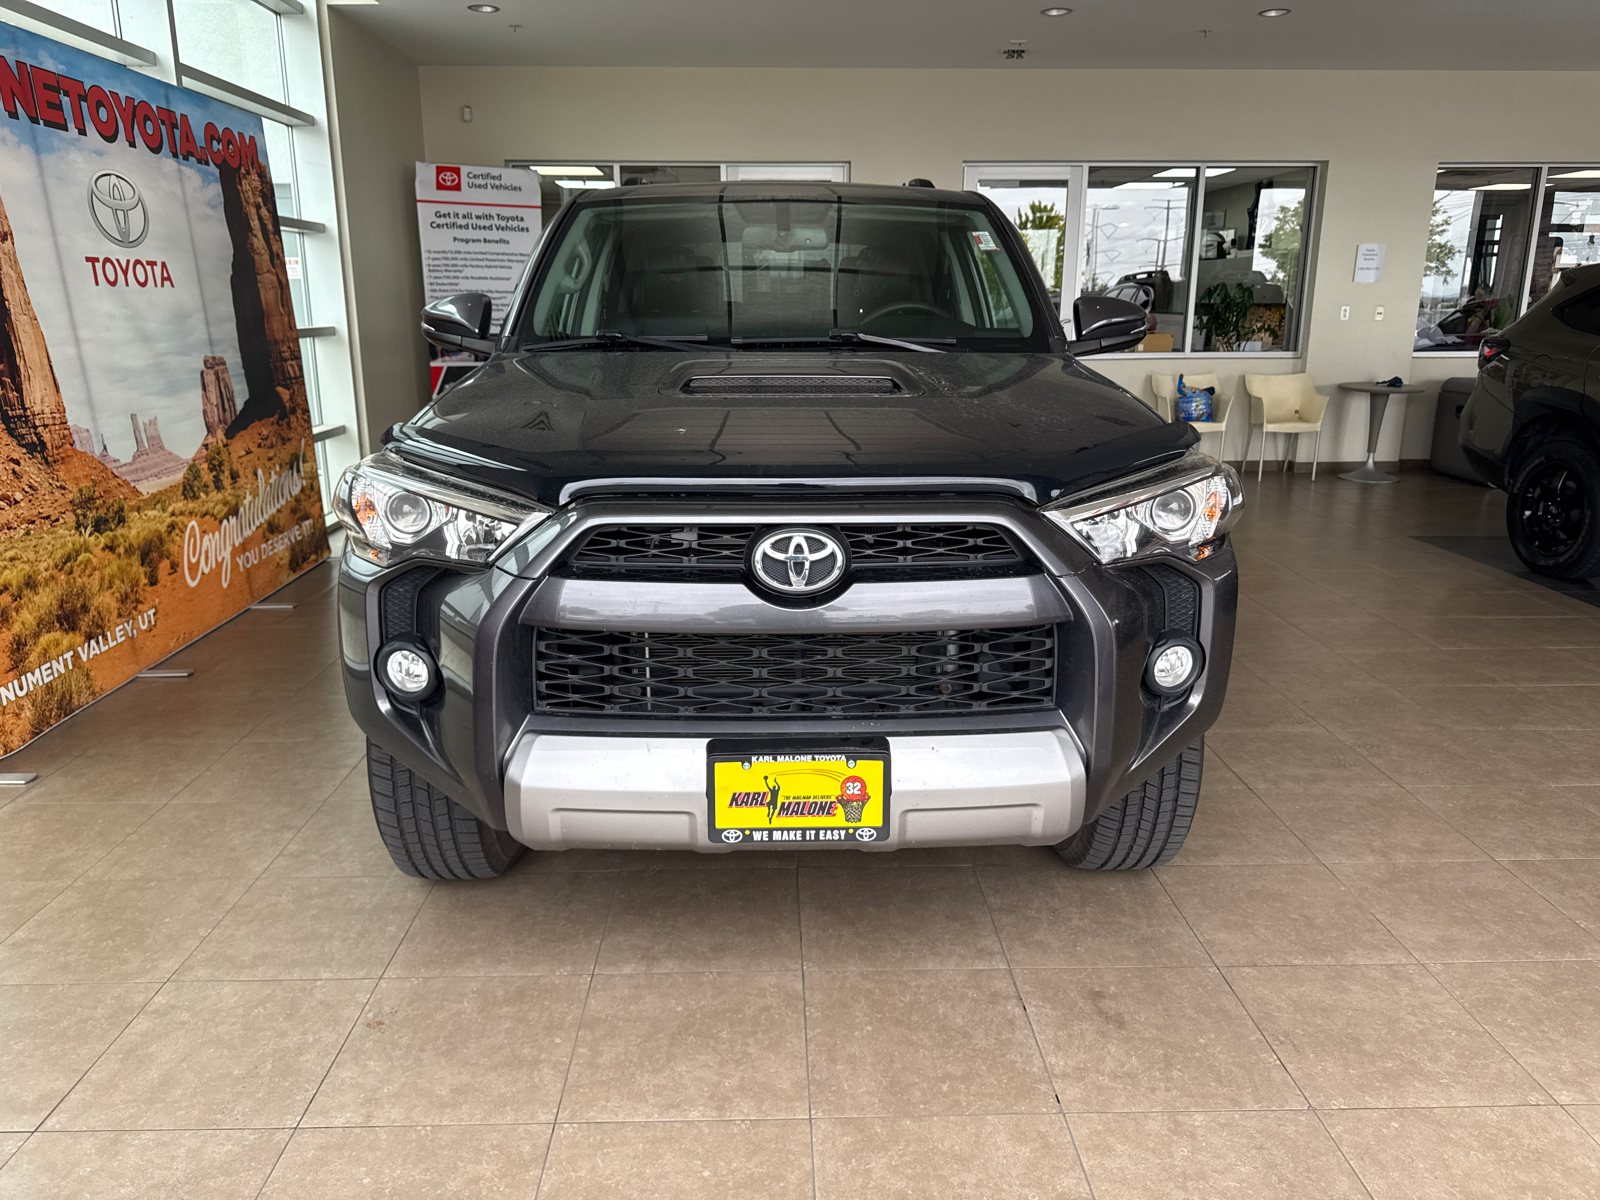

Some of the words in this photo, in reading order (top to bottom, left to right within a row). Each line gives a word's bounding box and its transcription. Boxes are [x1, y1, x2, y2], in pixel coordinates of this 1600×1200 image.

[467, 171, 502, 181] Certified
[467, 181, 488, 189] Used
[489, 182, 522, 192] Vehicles
[434, 211, 451, 219] Get
[453, 211, 460, 219] it
[462, 212, 473, 220] all
[474, 213, 494, 221] with
[496, 213, 525, 223] Toyota
[430, 221, 469, 230] Certified
[471, 223, 493, 231] Used
[494, 223, 530, 233] Vehicles
[453, 236, 482, 245] Program
[483, 237, 510, 245] Benefits
[85, 256, 175, 288] TOYOTA
[184, 438, 307, 588] Congratulations!
[236, 547, 259, 571] YOU
[261, 524, 302, 560] DESERVE
[302, 518, 314, 537] IT!
[77, 619, 137, 662] VALLEY,
[138, 608, 156, 630] UT
[845, 782, 861, 795] 32
[728, 791, 769, 808] KARL
[776, 801, 837, 817] MALONE
[753, 831, 769, 841] WE
[773, 830, 802, 841] MAKE
[806, 830, 815, 840] IT
[819, 830, 846, 841] EASY
